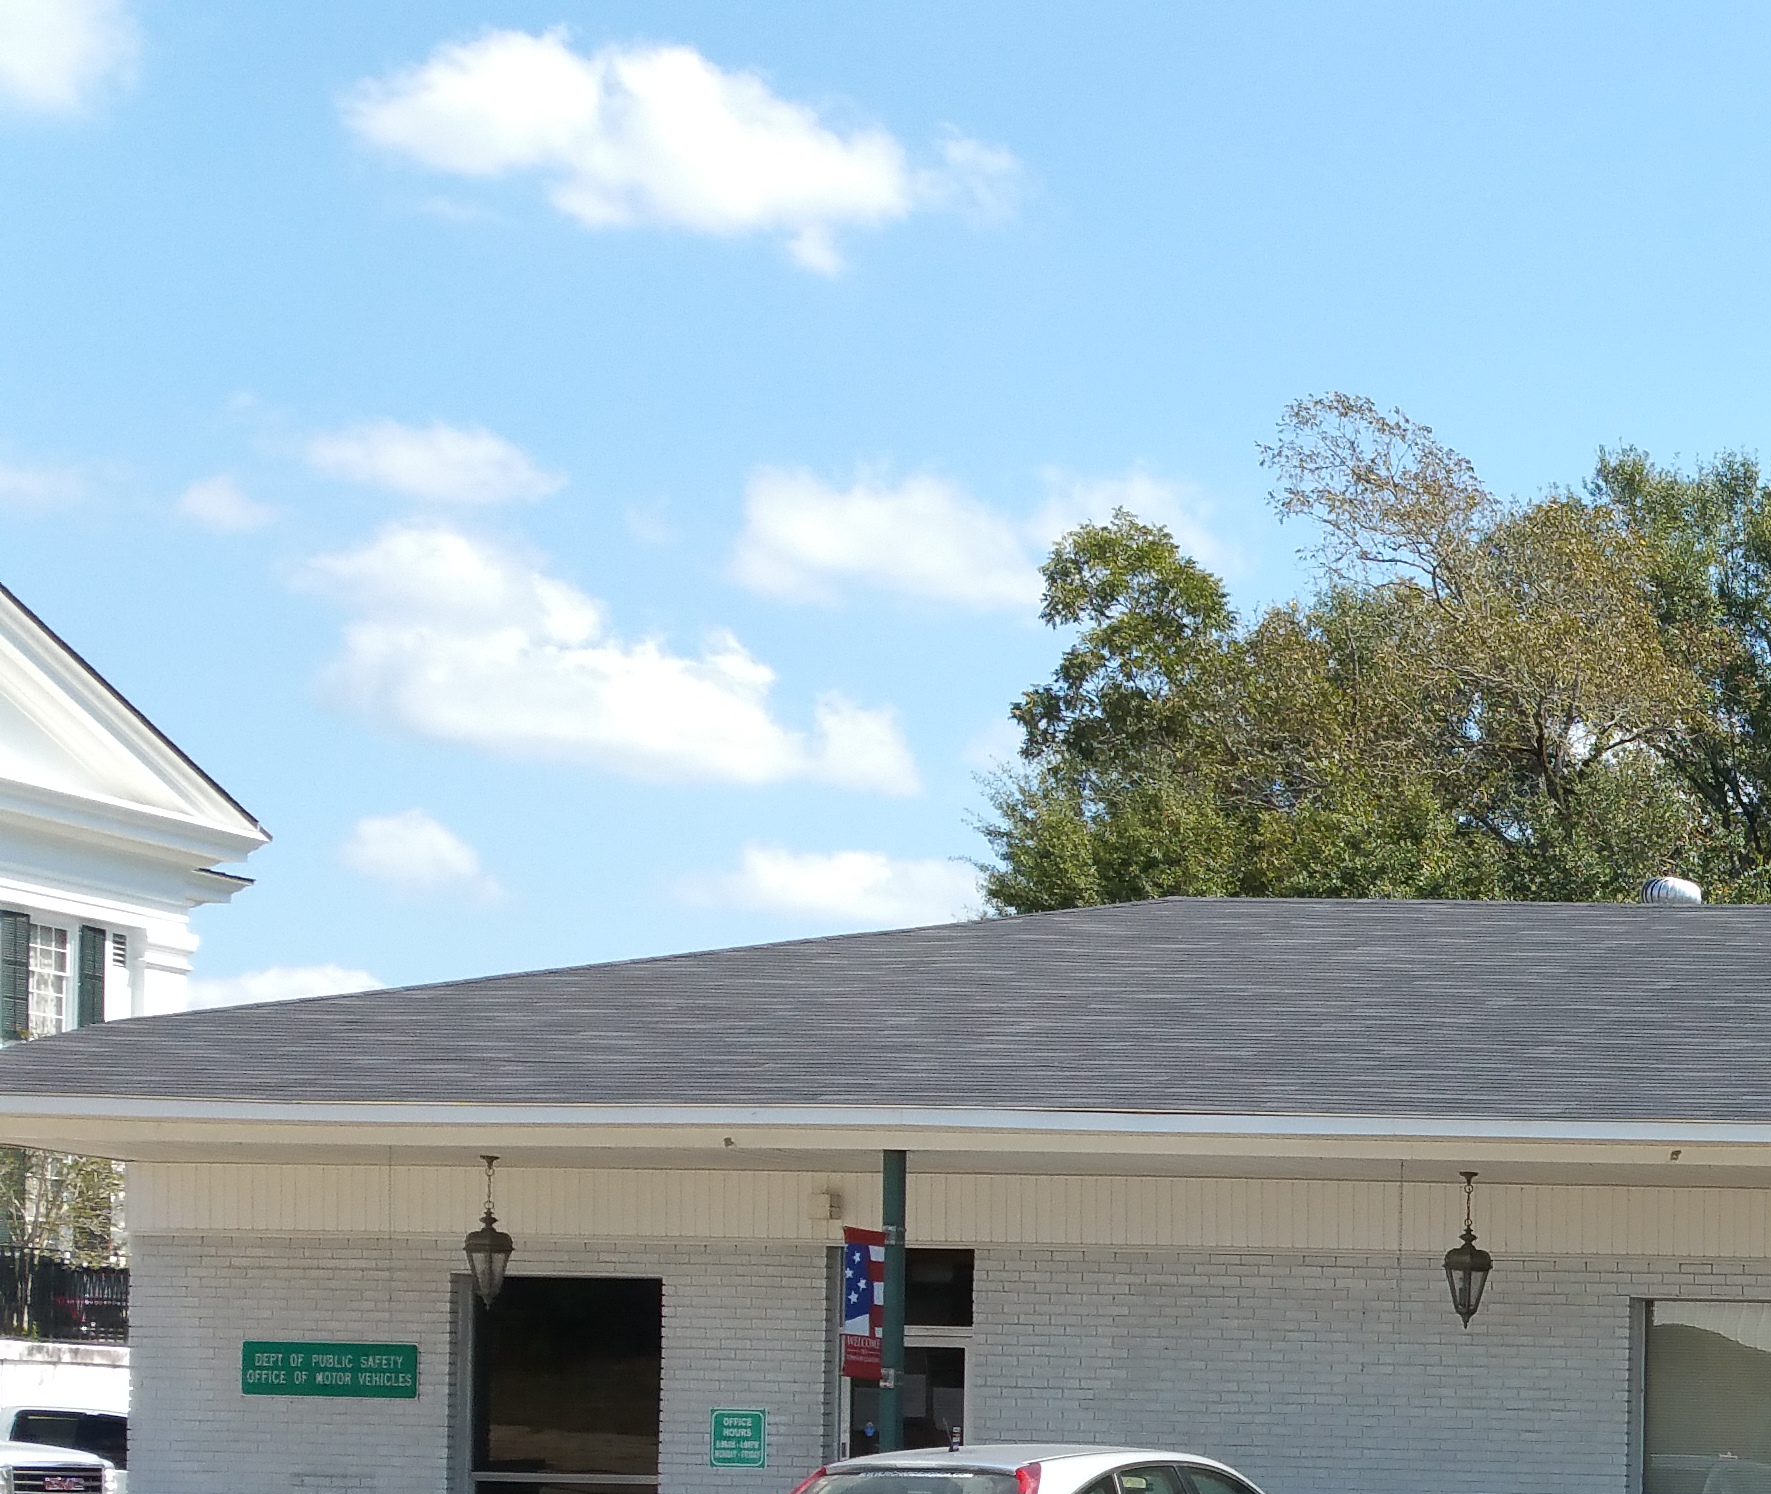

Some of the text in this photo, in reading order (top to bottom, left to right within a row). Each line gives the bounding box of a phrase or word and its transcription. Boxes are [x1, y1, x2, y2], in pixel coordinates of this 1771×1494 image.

[846, 1336, 880, 1349] WELCOME
[255, 1354, 403, 1368] DEPT OF PUBLIC SAFETY
[247, 1370, 412, 1386] OFFICE OF MOTOR VEHICLES
[723, 1418, 752, 1426] OFFICE
[723, 1428, 752, 1436] HOURS
